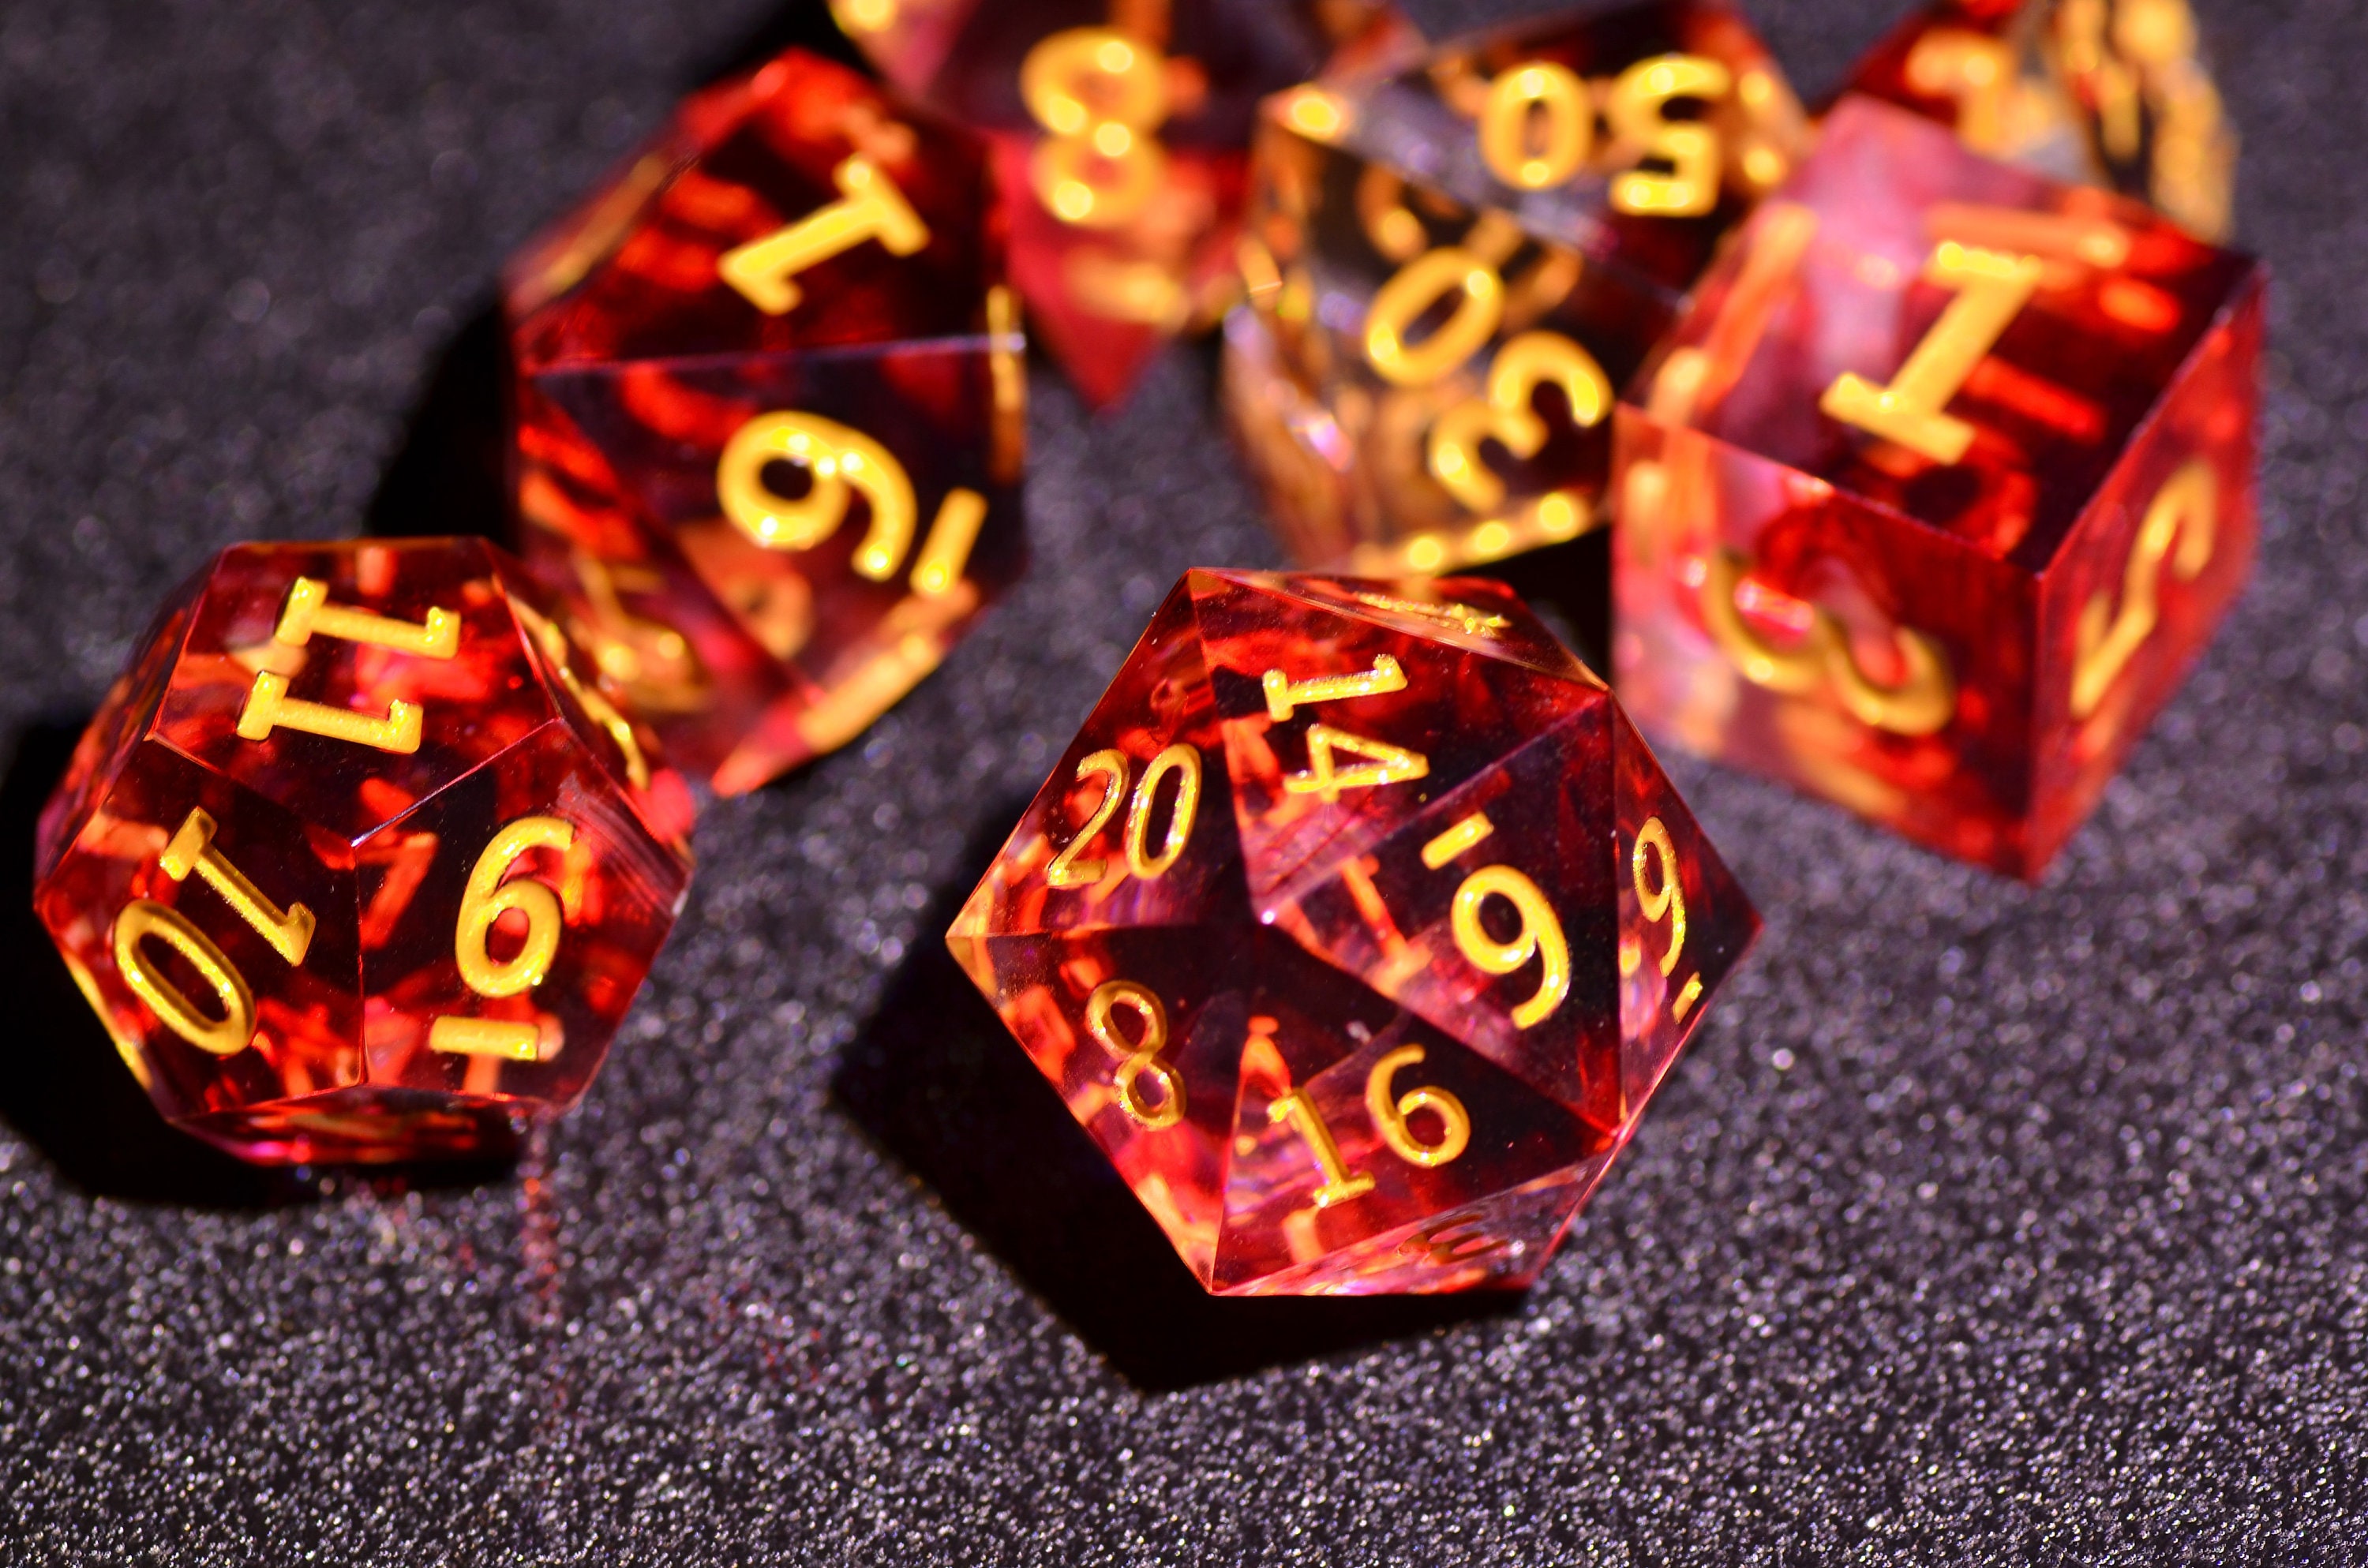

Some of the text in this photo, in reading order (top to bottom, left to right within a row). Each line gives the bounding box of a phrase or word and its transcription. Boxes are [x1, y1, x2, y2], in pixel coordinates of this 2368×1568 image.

[1021, 27, 1170, 227] 8
[1480, 55, 1727, 216] 50
[717, 159, 930, 316] 1
[1363, 246, 1612, 511] 30
[1820, 238, 2043, 467] 1
[237, 577, 461, 754] 11
[1263, 654, 1430, 803] 14
[1046, 743, 1202, 889] 20
[1632, 816, 1687, 978] 9
[113, 806, 317, 1054] 10
[455, 816, 575, 998] 6
[1085, 979, 1186, 1132] 8
[1266, 1044, 1471, 1208] 16
